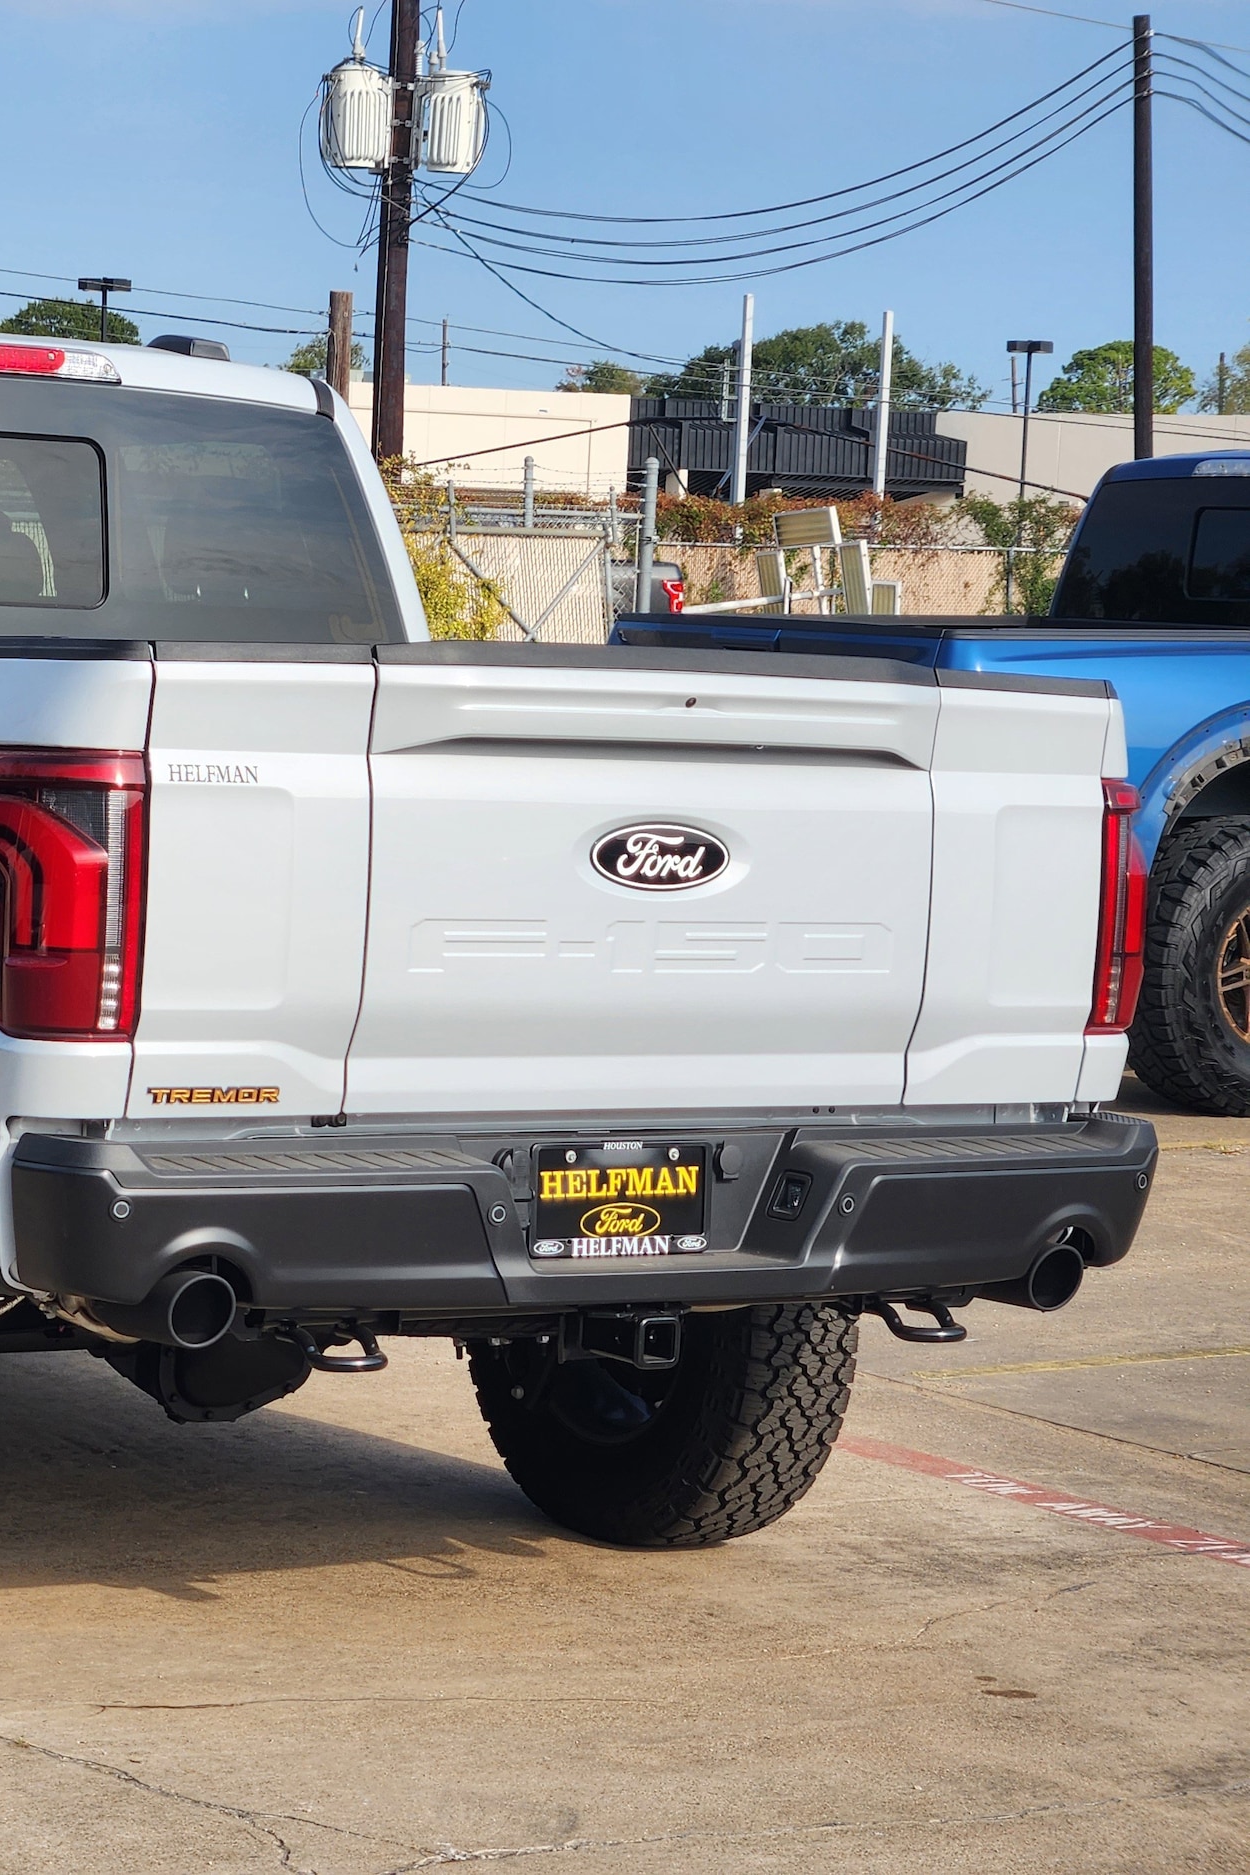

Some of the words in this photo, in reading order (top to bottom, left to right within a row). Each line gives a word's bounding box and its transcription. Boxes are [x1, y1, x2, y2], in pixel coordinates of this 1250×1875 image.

[167, 763, 259, 784] HELFMAN
[616, 832, 707, 879] Ford
[408, 918, 893, 973] F-150
[147, 1087, 280, 1104] TREMOR
[603, 1141, 644, 1150] HOUSTON
[540, 1166, 700, 1199] HELFMAN
[595, 1207, 645, 1234] Ford
[571, 1235, 670, 1257] HELFMAN
